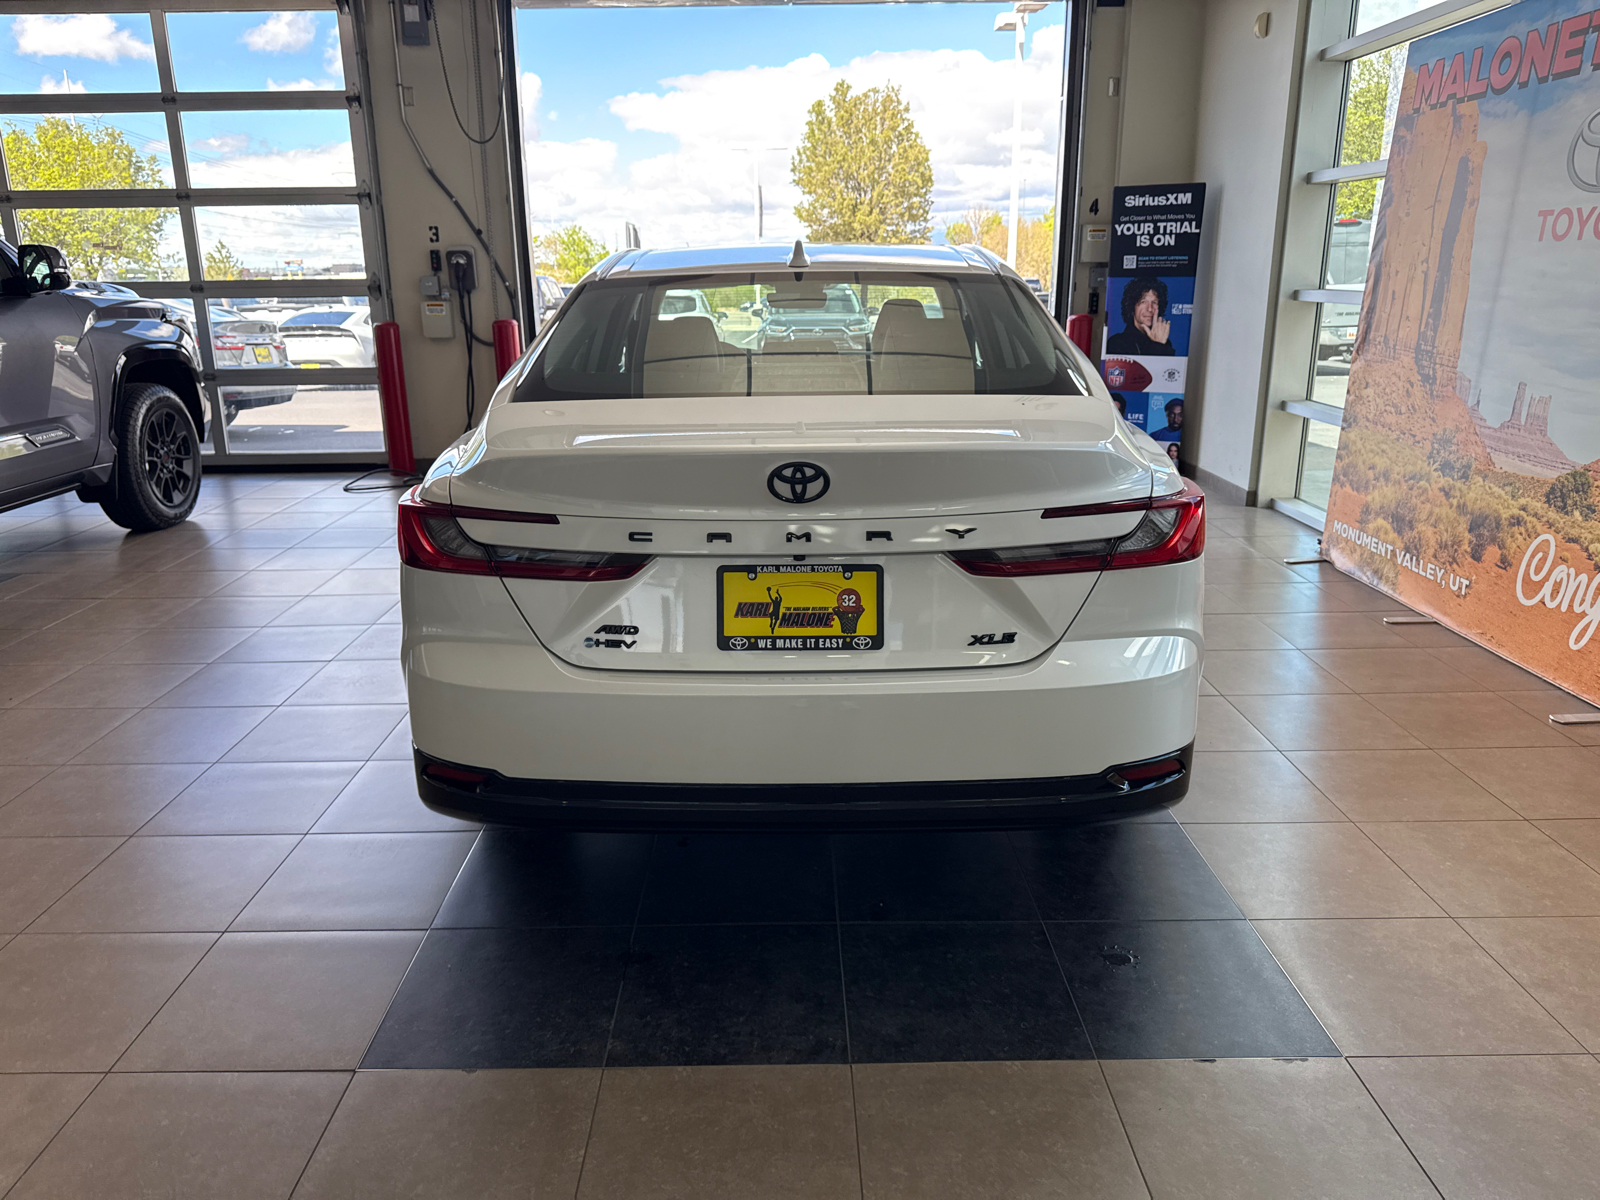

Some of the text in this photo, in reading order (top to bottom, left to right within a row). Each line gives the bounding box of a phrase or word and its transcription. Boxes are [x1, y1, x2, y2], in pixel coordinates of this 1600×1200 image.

[1089, 198, 1099, 216] 4
[1124, 192, 1192, 207] SiriusXM
[428, 226, 440, 243] 3
[1115, 222, 1154, 236] YOUR
[1157, 221, 1200, 234] TRIAL
[1136, 234, 1176, 247] IS ON
[628, 527, 978, 543] CAMRY
[1332, 520, 1470, 596] MONUMENT VALLEY, UT
[813, 565, 843, 573] TOYOTA
[841, 594, 856, 607] 32
[734, 602, 773, 618] KARL
[778, 611, 835, 628] MALONE
[593, 624, 639, 636] AWD
[594, 638, 638, 650] HEV
[757, 638, 844, 649] WE MAKE IT EASY
[966, 631, 1018, 647] XLE
